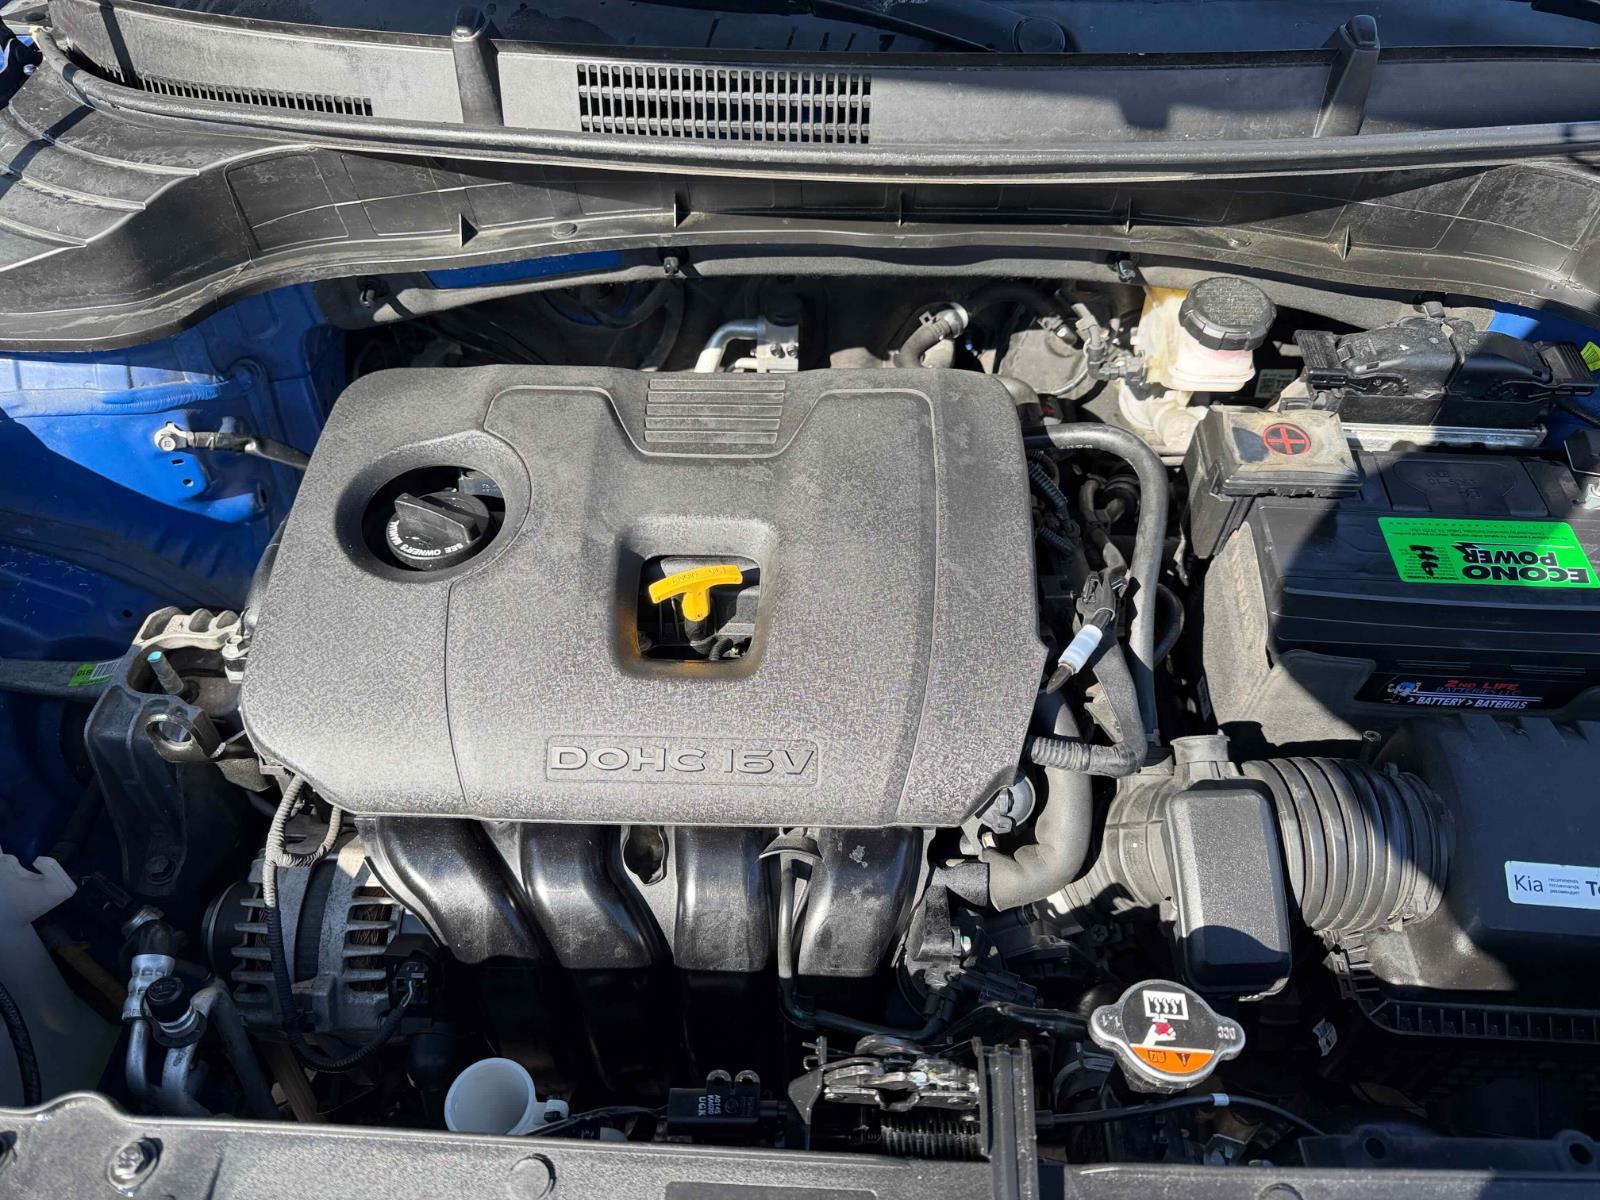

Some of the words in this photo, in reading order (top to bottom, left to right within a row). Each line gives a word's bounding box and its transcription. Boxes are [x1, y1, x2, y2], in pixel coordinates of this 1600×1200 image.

[400, 544, 441, 556] OWNER'S
[444, 542, 464, 553] SEE
[1462, 549, 1559, 568] POWER
[1462, 565, 1590, 584] ECONO
[1416, 697, 1466, 706] BATTERY
[1474, 699, 1528, 709] BATERIAS
[550, 745, 706, 772] DOHC
[724, 748, 815, 775] 16V
[1514, 874, 1544, 893] Kia
[1585, 880, 1600, 897] T
